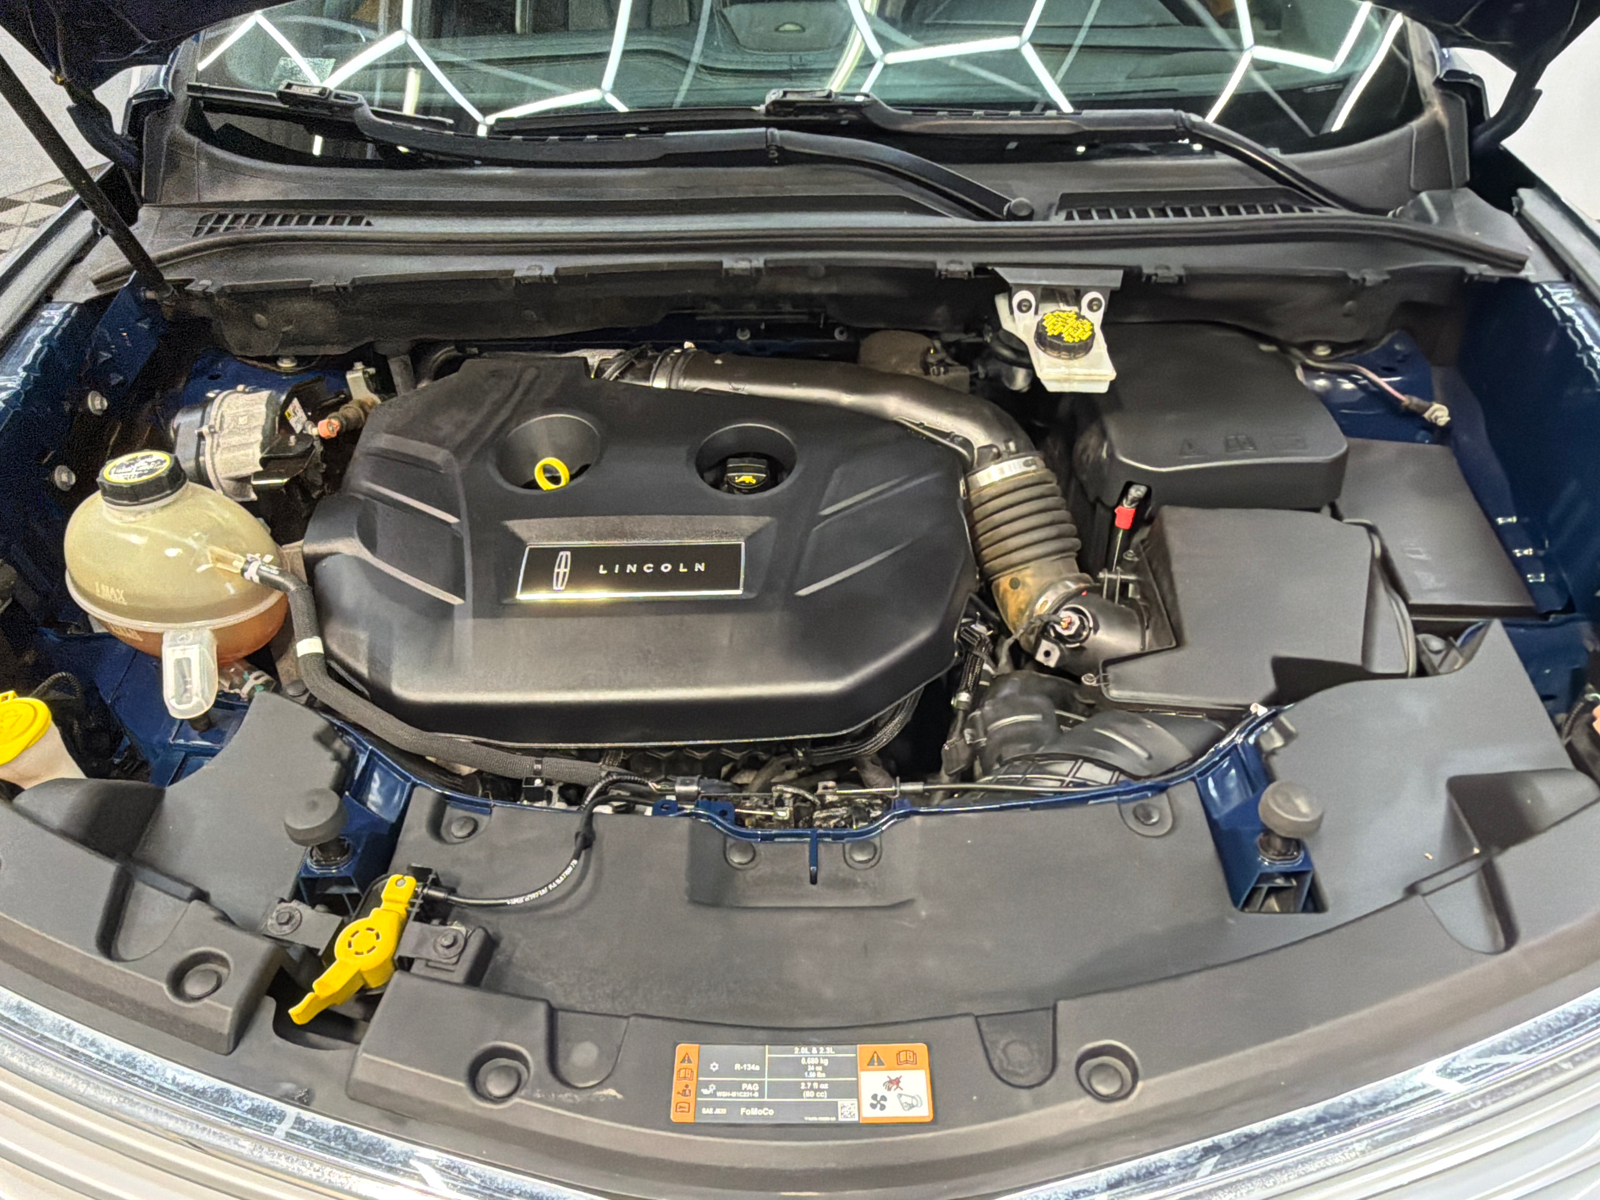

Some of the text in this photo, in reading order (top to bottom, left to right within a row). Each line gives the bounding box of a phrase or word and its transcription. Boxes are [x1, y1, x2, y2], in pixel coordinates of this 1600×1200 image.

[599, 563, 705, 574] LINCOLN
[819, 1046, 835, 1054] 2.3L
[820, 1057, 829, 1066] kg
[734, 1063, 760, 1071] R-134a
[741, 1083, 759, 1091] PAG
[800, 1082, 812, 1090] 2.7
[812, 1081, 819, 1089] fl
[815, 1090, 828, 1098] cc)
[740, 1107, 775, 1116] FoMoCo
